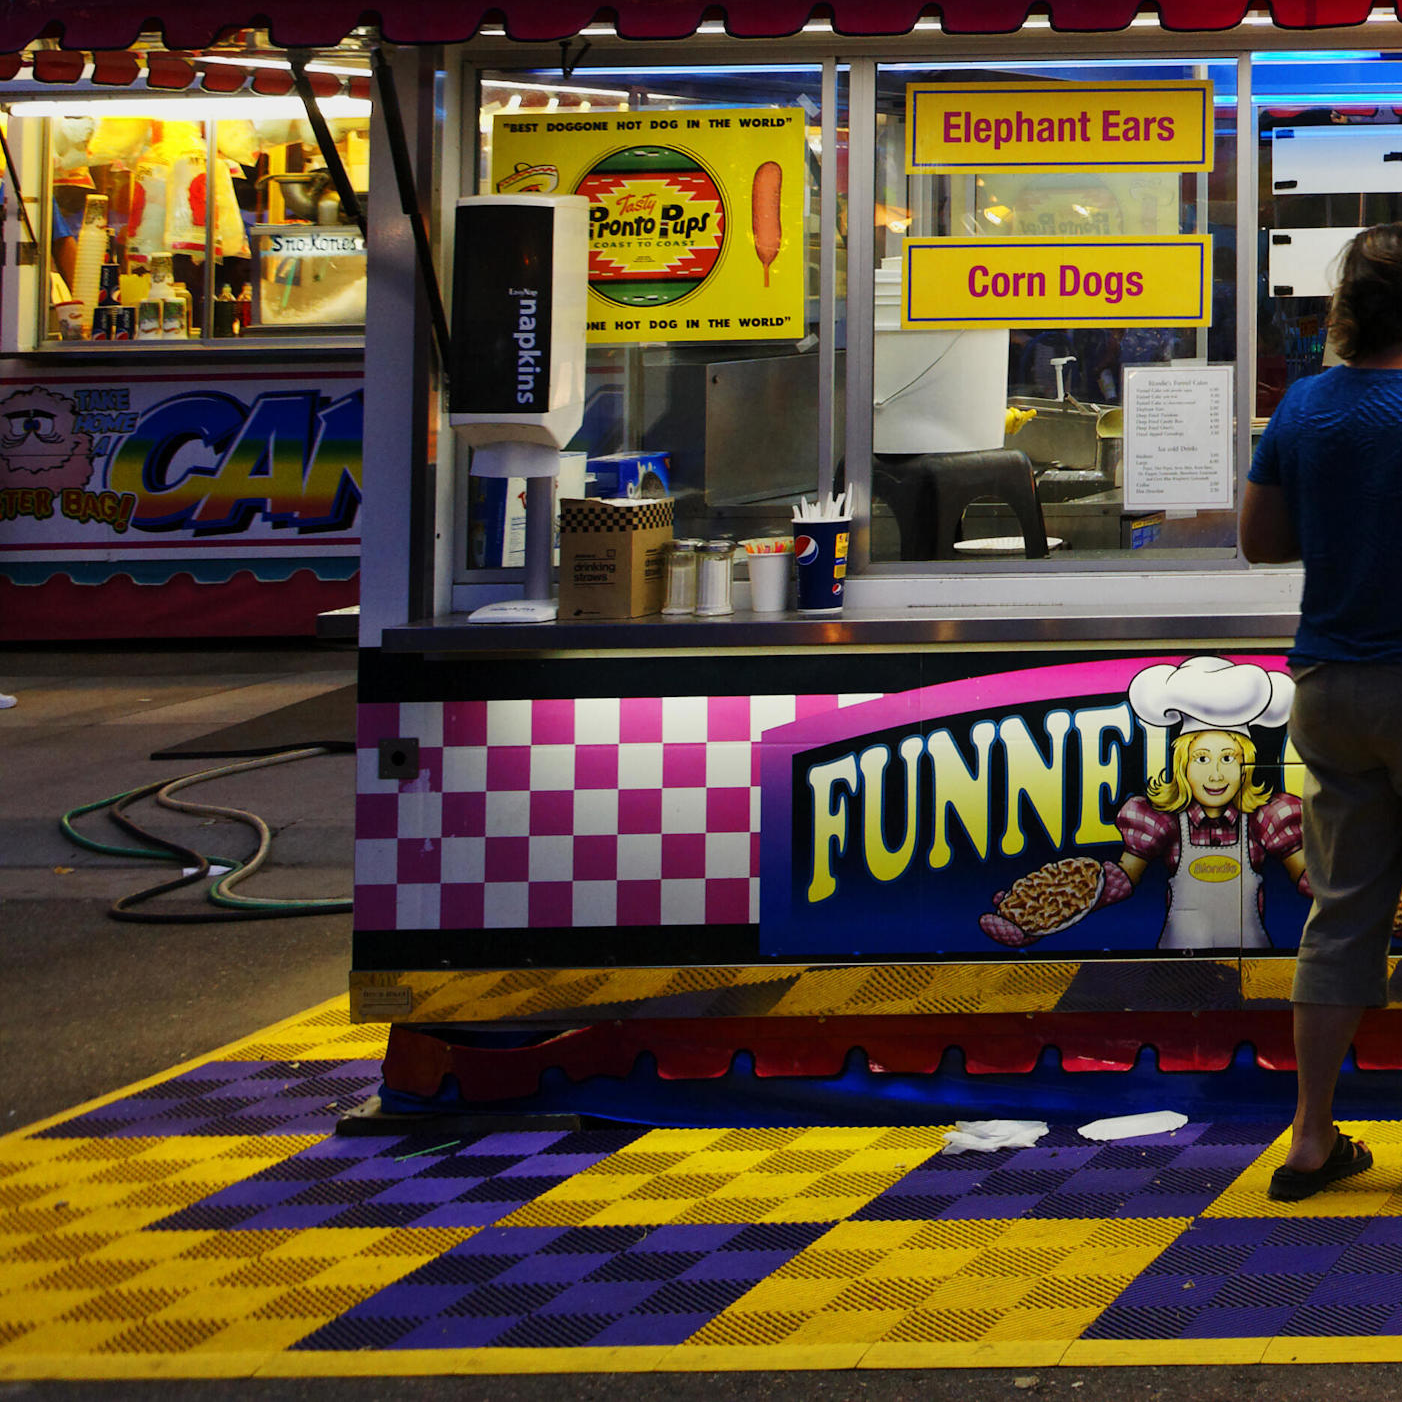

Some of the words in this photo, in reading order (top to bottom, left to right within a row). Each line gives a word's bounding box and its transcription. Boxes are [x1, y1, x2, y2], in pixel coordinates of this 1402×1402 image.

[547, 122, 608, 132] DOGGONE
[616, 121, 642, 131] HOT
[650, 120, 679, 130] DOG
[687, 119, 700, 129] IN
[709, 119, 731, 128] THE
[739, 117, 792, 128] WORLD"
[943, 111, 1092, 150] Elephant
[1102, 109, 1176, 144] Ears
[616, 193, 657, 216] Tasty
[659, 204, 710, 239] Pups
[594, 241, 632, 249] COAST
[967, 264, 1049, 297] Corn
[1059, 263, 1144, 303] Dogs
[615, 320, 641, 330] HOT
[649, 319, 678, 329] DOG
[686, 319, 700, 329] IN
[709, 318, 731, 328] THE
[739, 316, 791, 327] WORLD"
[512, 299, 542, 404] napkins
[74, 388, 131, 411] TAKE
[73, 413, 140, 434] HOME
[93, 436, 111, 456] A
[61, 489, 137, 534] BAG!
[574, 562, 616, 573] drinking
[574, 574, 608, 582] straws
[1192, 859, 1240, 879] Blondie
